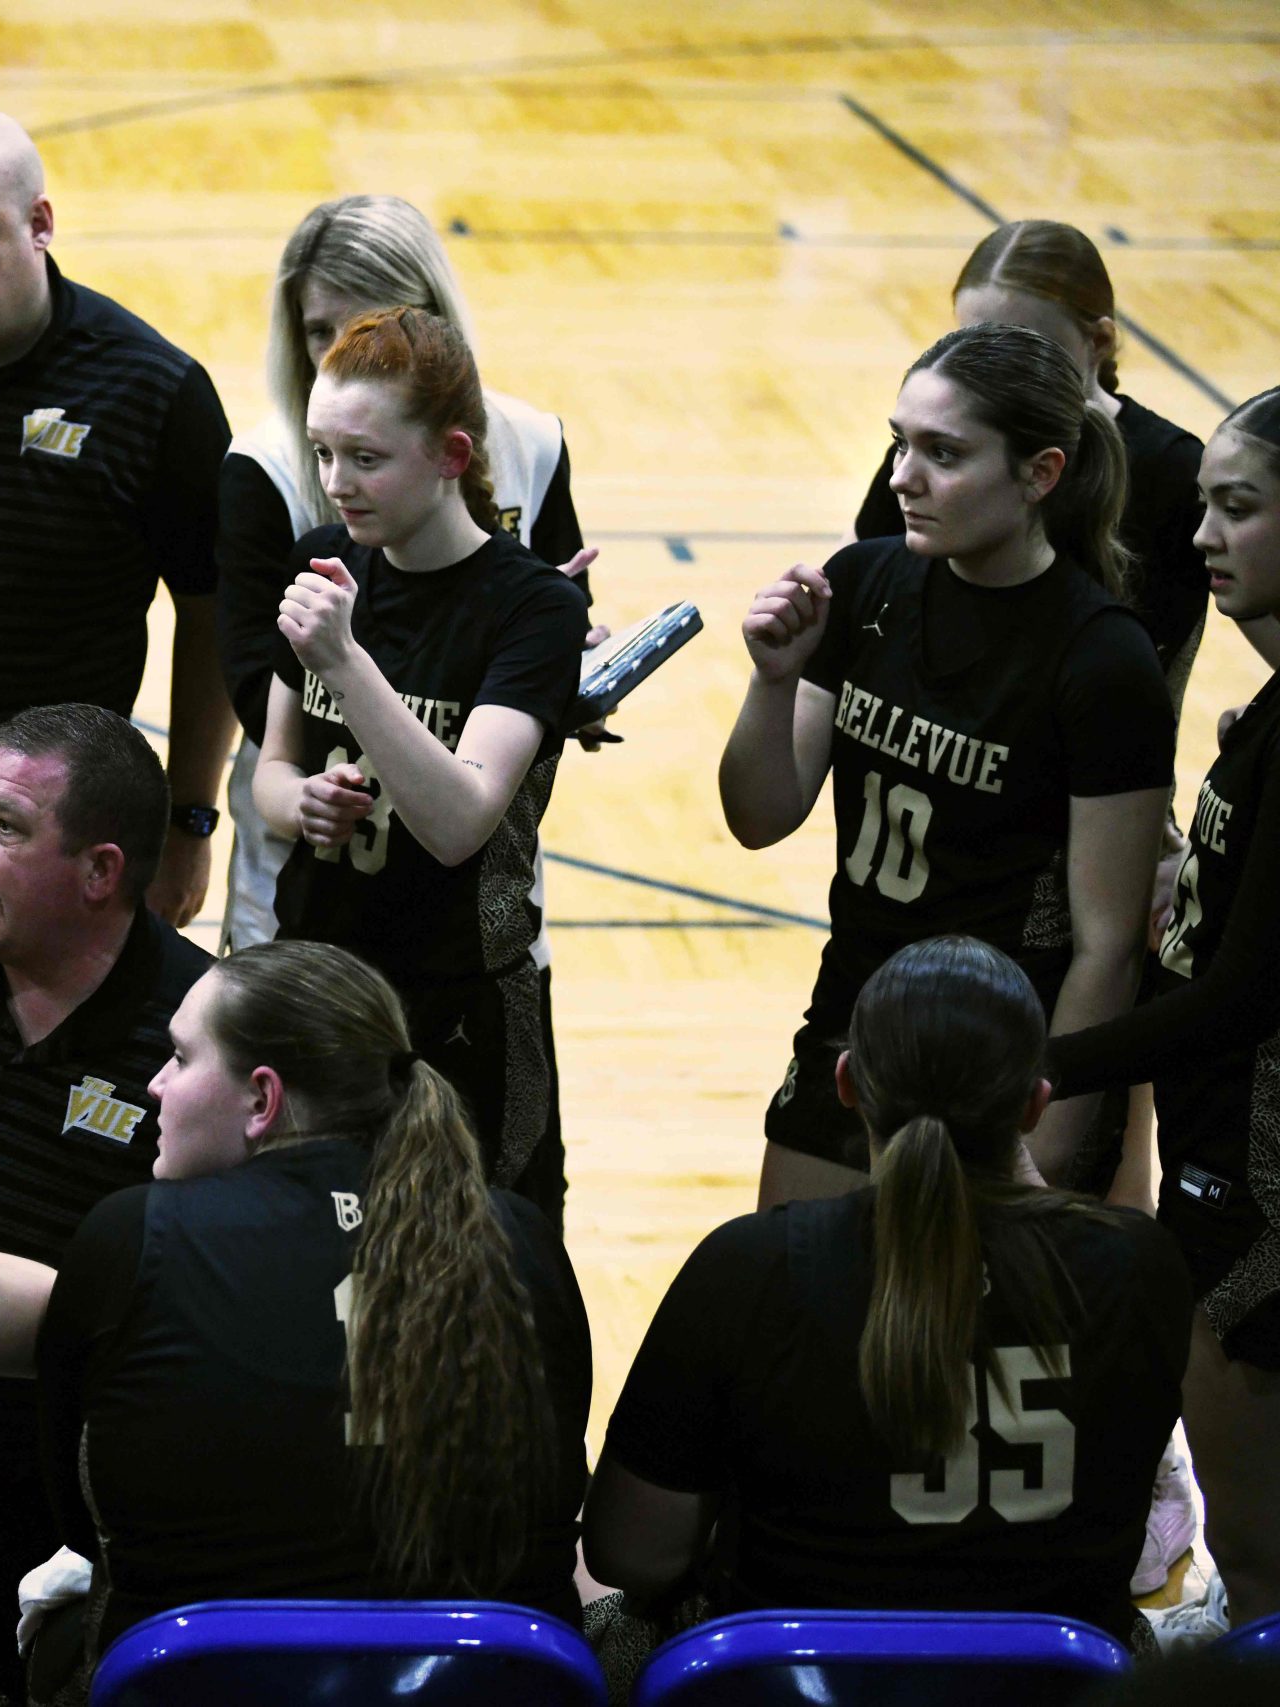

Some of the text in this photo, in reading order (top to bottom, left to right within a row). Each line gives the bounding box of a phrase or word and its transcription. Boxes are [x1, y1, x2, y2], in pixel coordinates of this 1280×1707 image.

[20, 415, 91, 458] VUE
[835, 680, 1009, 794] BELLEVUE
[845, 770, 933, 904] 10
[61, 1084, 148, 1144] VUE
[1208, 1184, 1221, 1199] M
